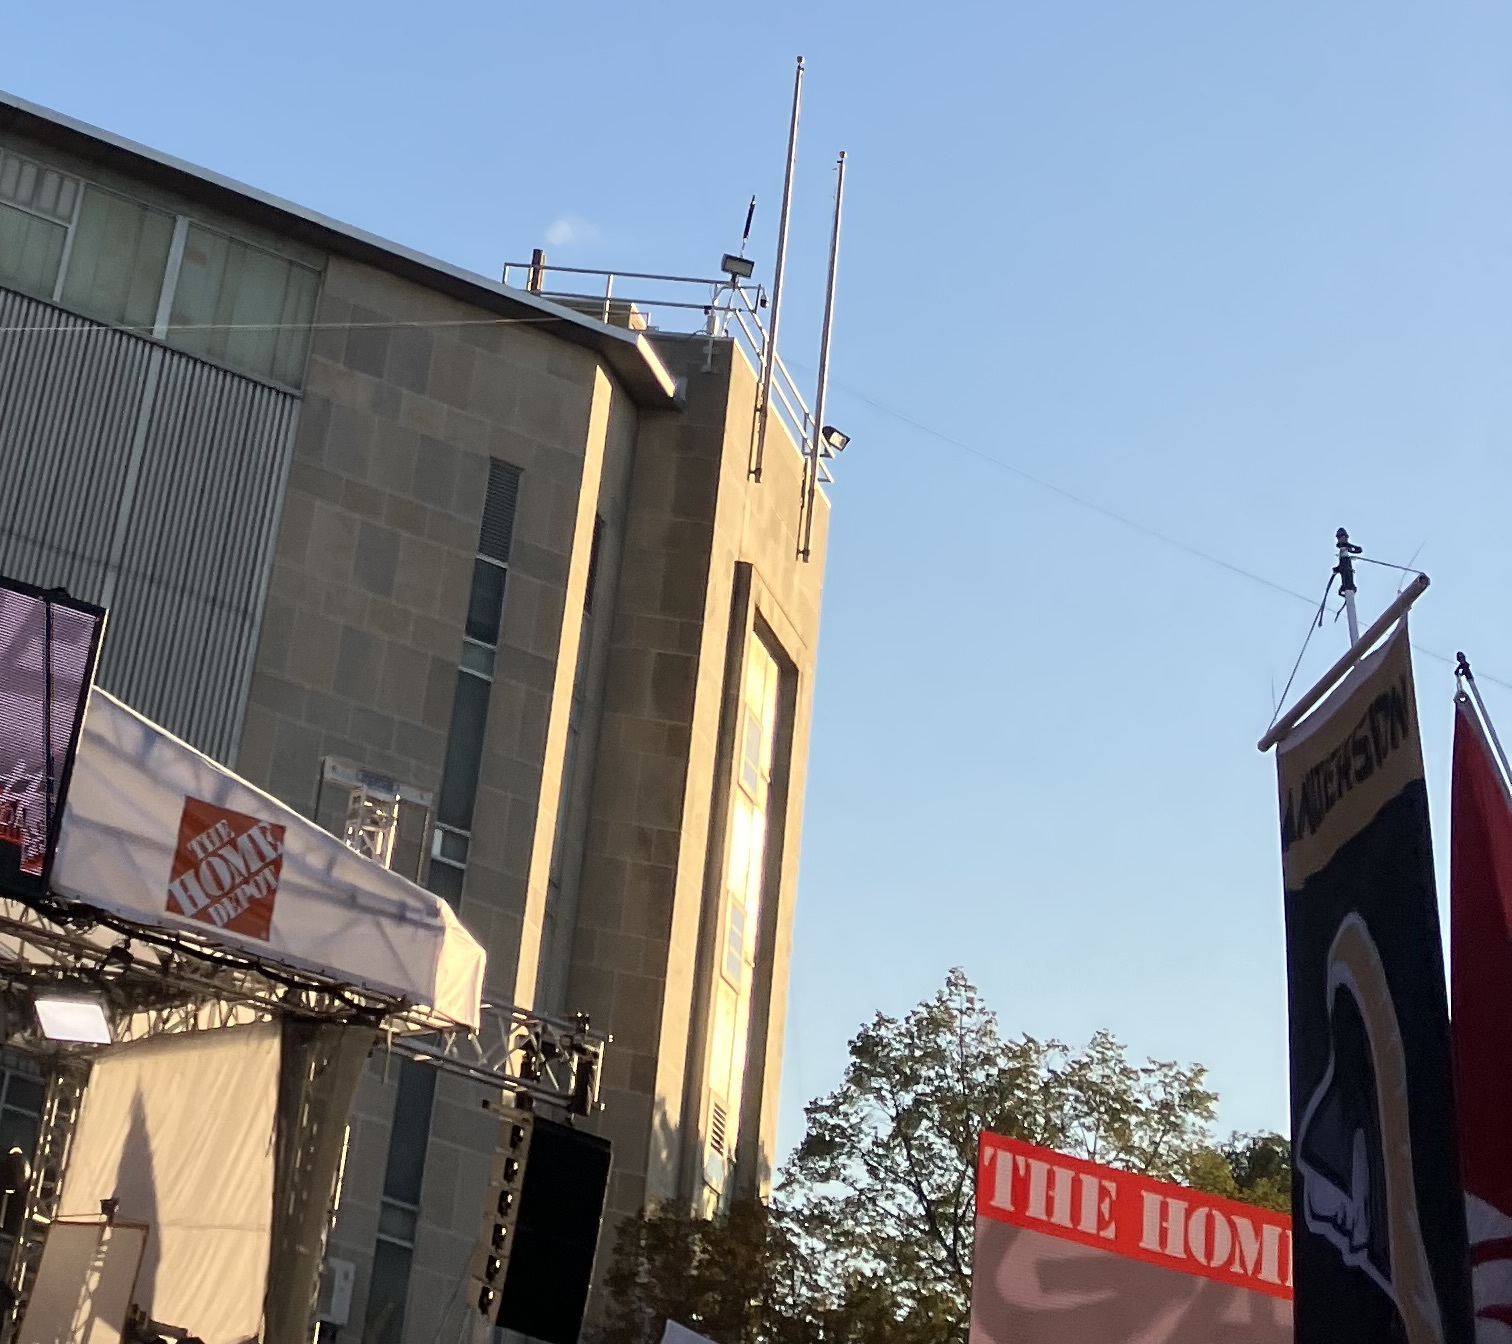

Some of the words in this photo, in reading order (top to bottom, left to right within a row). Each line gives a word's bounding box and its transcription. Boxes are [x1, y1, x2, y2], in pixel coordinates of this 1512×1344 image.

[168, 820, 284, 918] HOME
[187, 819, 235, 861] THE
[207, 865, 278, 928] DEPOT
[984, 1146, 1117, 1241] THE
[1138, 1189, 1293, 1288] HOM
